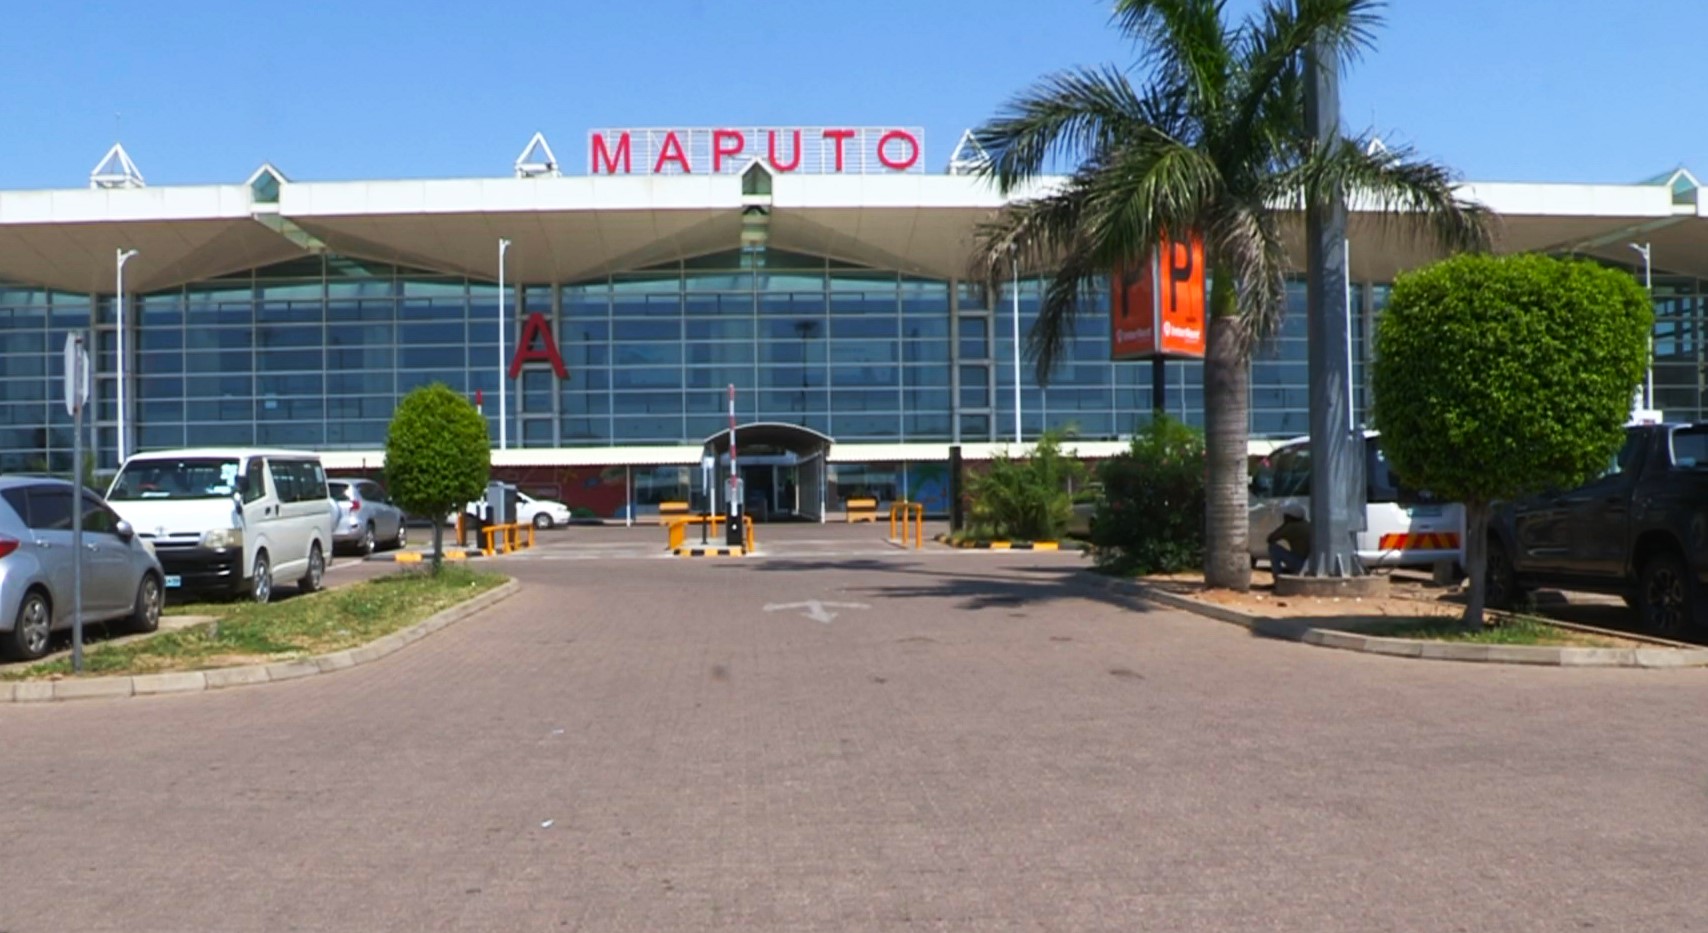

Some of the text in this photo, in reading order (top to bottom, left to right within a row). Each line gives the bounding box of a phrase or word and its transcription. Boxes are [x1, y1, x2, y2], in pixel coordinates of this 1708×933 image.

[592, 130, 919, 173] MAPUTO
[1169, 232, 1193, 312] P
[508, 312, 569, 379] A
